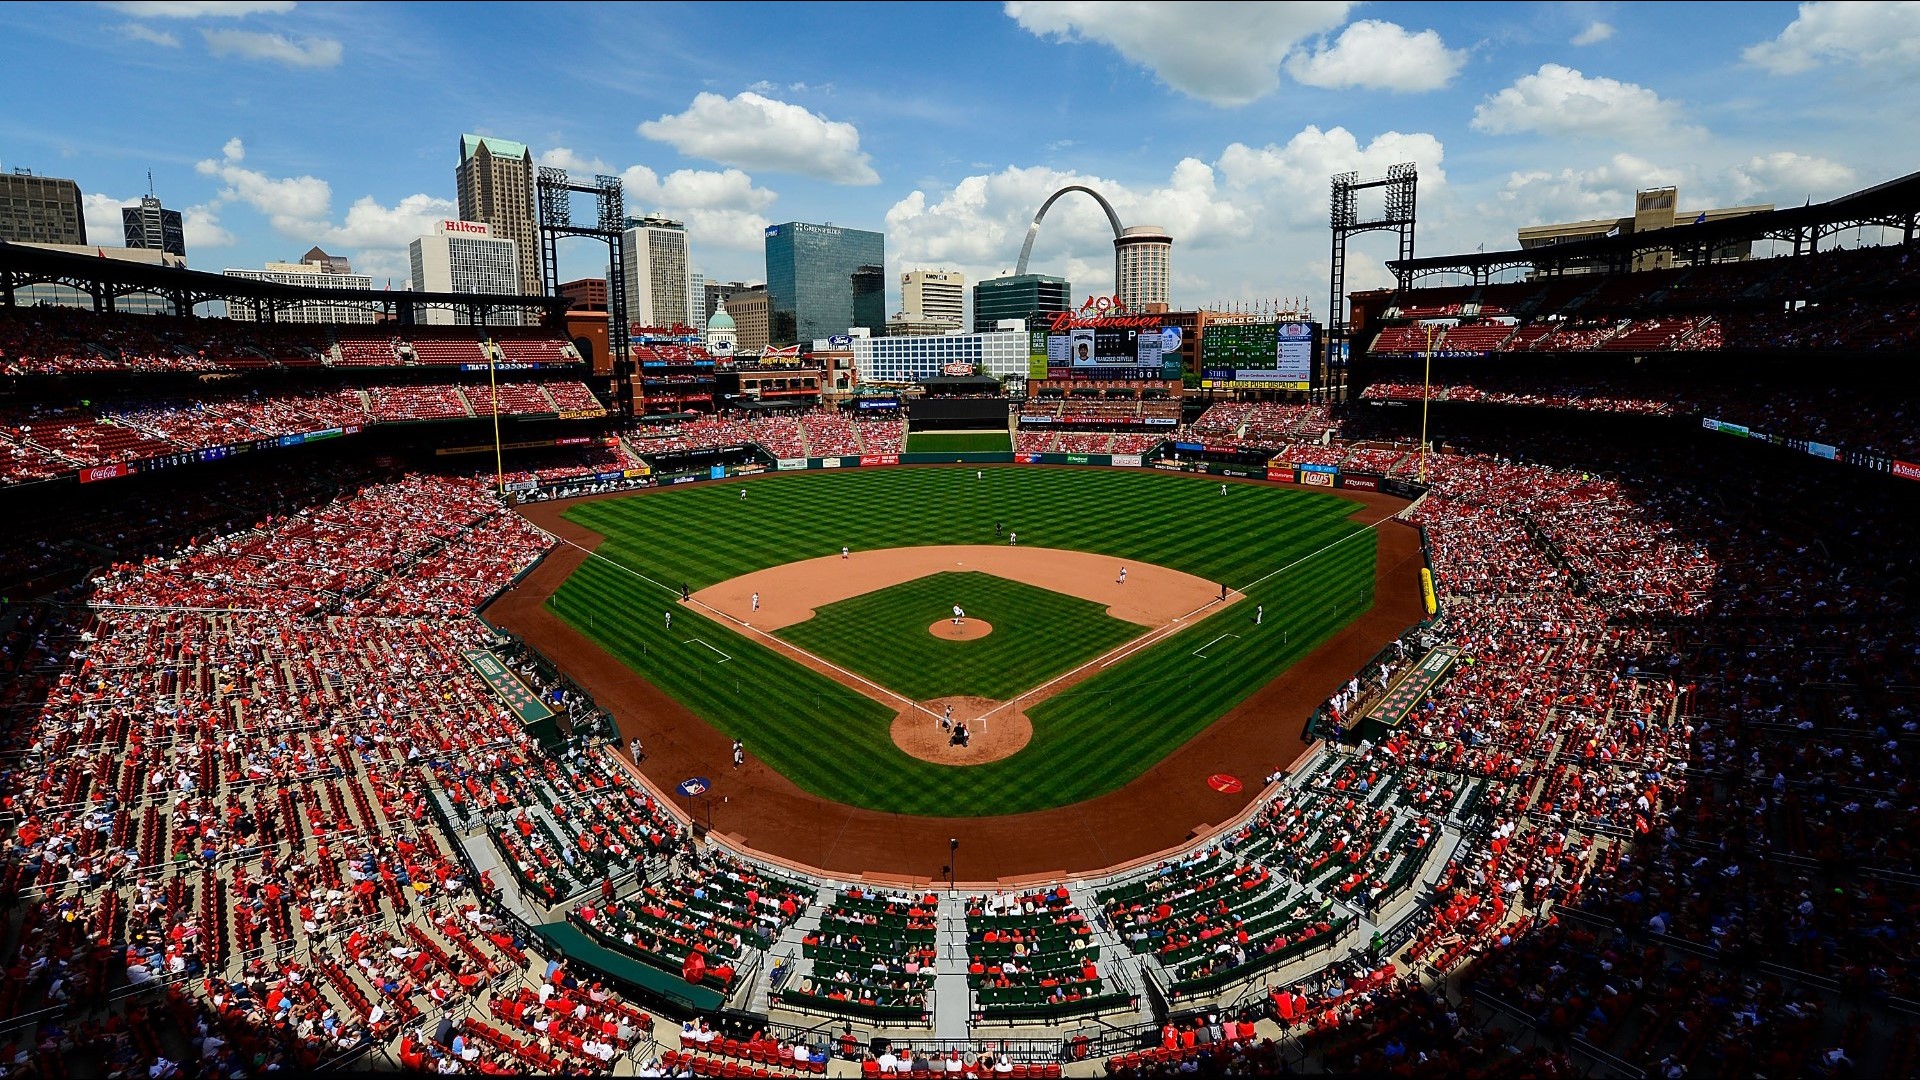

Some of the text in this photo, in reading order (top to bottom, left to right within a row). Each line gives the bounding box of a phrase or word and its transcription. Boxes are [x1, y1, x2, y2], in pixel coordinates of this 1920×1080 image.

[445, 221, 487, 234] Hilton
[1047, 311, 1163, 331] Budweiser
[1246, 314, 1301, 323] CHAMPIONS
[630, 322, 669, 336] Cardinals
[1128, 330, 1136, 341] P
[765, 348, 801, 357] Budweiser
[761, 357, 801, 365] BREW HOUSE
[467, 363, 489, 371] THAT'S
[948, 365, 971, 374] Coca-Cola
[1250, 381, 1298, 389] POST-DISPATCH
[565, 411, 580, 419] BIG
[173, 458, 178, 466] 0
[182, 456, 187, 464] 0
[1869, 460, 1874, 469] 0
[1877, 461, 1882, 471] 0
[90, 465, 117, 480] Coca-Cola
[1344, 479, 1375, 488] EQUIFAX
[1167, 1030, 1173, 1040] 4
